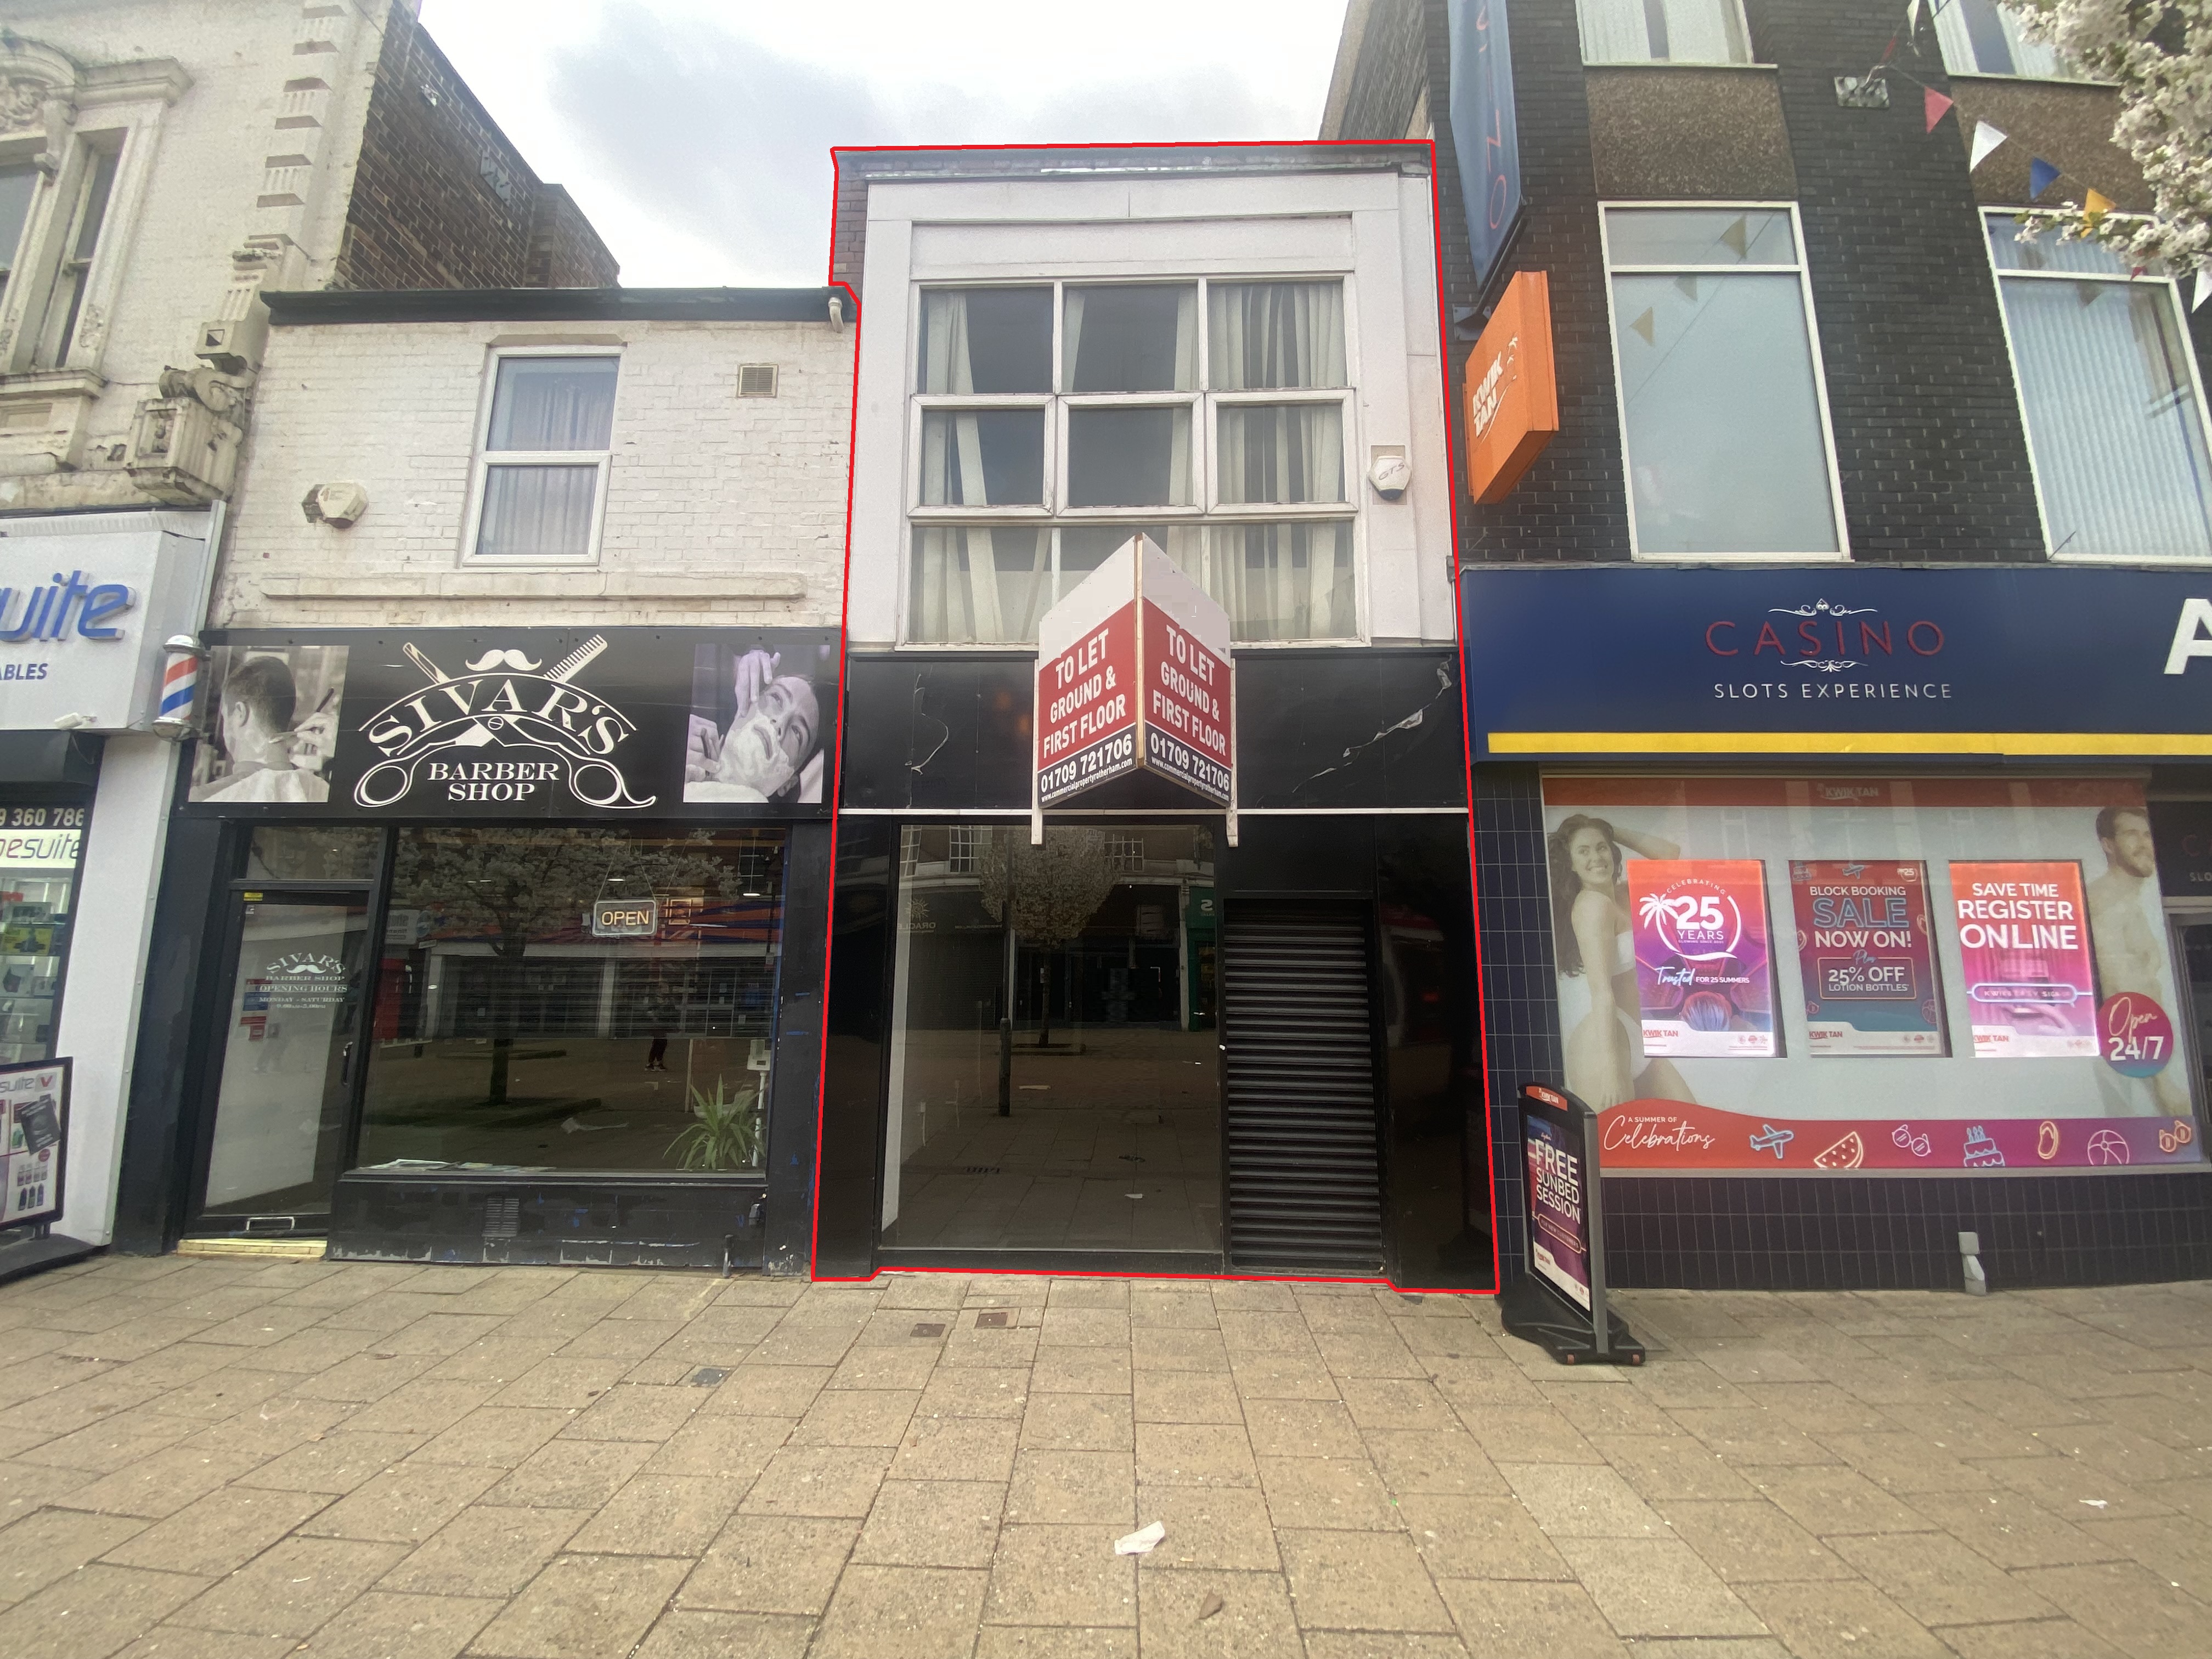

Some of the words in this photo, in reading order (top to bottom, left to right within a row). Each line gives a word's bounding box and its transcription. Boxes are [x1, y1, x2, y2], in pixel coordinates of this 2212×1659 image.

[1474, 386, 1497, 438] TAN
[1379, 462, 1405, 481] GTS
[1705, 620, 1945, 656] CASINO
[1055, 654, 1074, 690] TO
[1078, 628, 1109, 676] LET
[1165, 624, 1186, 664] TO
[1189, 644, 1215, 686] LET
[0, 663, 49, 681] BLES
[1049, 674, 1102, 724] GROUND
[1105, 665, 1116, 691] &
[1160, 661, 1210, 714] GROUND
[1211, 698, 1220, 723] &
[1713, 683, 1788, 698] SLOTS
[1802, 683, 1952, 698] EXPERIENCE
[368, 678, 629, 757] SIVAR'S
[1043, 719, 1078, 759] FIRST
[1079, 693, 1126, 740] FLOOR
[1153, 689, 1189, 733] FIRST
[1191, 716, 1226, 757] FLOOR
[427, 763, 559, 781] BARBER
[1041, 760, 1077, 793] 01709
[1080, 733, 1132, 775] 721706
[1150, 732, 1189, 770] 01709
[1192, 754, 1230, 792] 721706
[448, 783, 535, 802] SHOP
[1041, 758, 1132, 803] www.commercialpropertyrotherham.com
[11, 808, 47, 827] 360
[53, 808, 85, 827] 786
[1666, 878, 1726, 895] CELEBRATING
[1809, 886, 1849, 896] BLOCK
[1851, 886, 1906, 896] BOOKING
[1972, 883, 2016, 897] SAVE
[2019, 883, 2059, 898] TIME
[600, 910, 650, 926] OPEN
[1676, 895, 1724, 930] 25
[1813, 898, 1910, 928] SALE
[1957, 900, 2074, 920] REGISTER
[1677, 930, 1724, 940] YEARS
[1814, 930, 1870, 947] NOW
[1872, 930, 1912, 948] ON!
[1960, 924, 2079, 950] ONLINE
[1654, 966, 1696, 986] Trusted
[1828, 966, 1865, 986] 25%
[1868, 967, 1905, 982] OFF
[2108, 996, 2158, 1045] Open
[2108, 1036, 2164, 1061] 24/7
[1604, 1115, 1716, 1152] Celebrations
[1535, 1139, 1578, 1187] FREE
[1536, 1167, 1579, 1204] SUNBED
